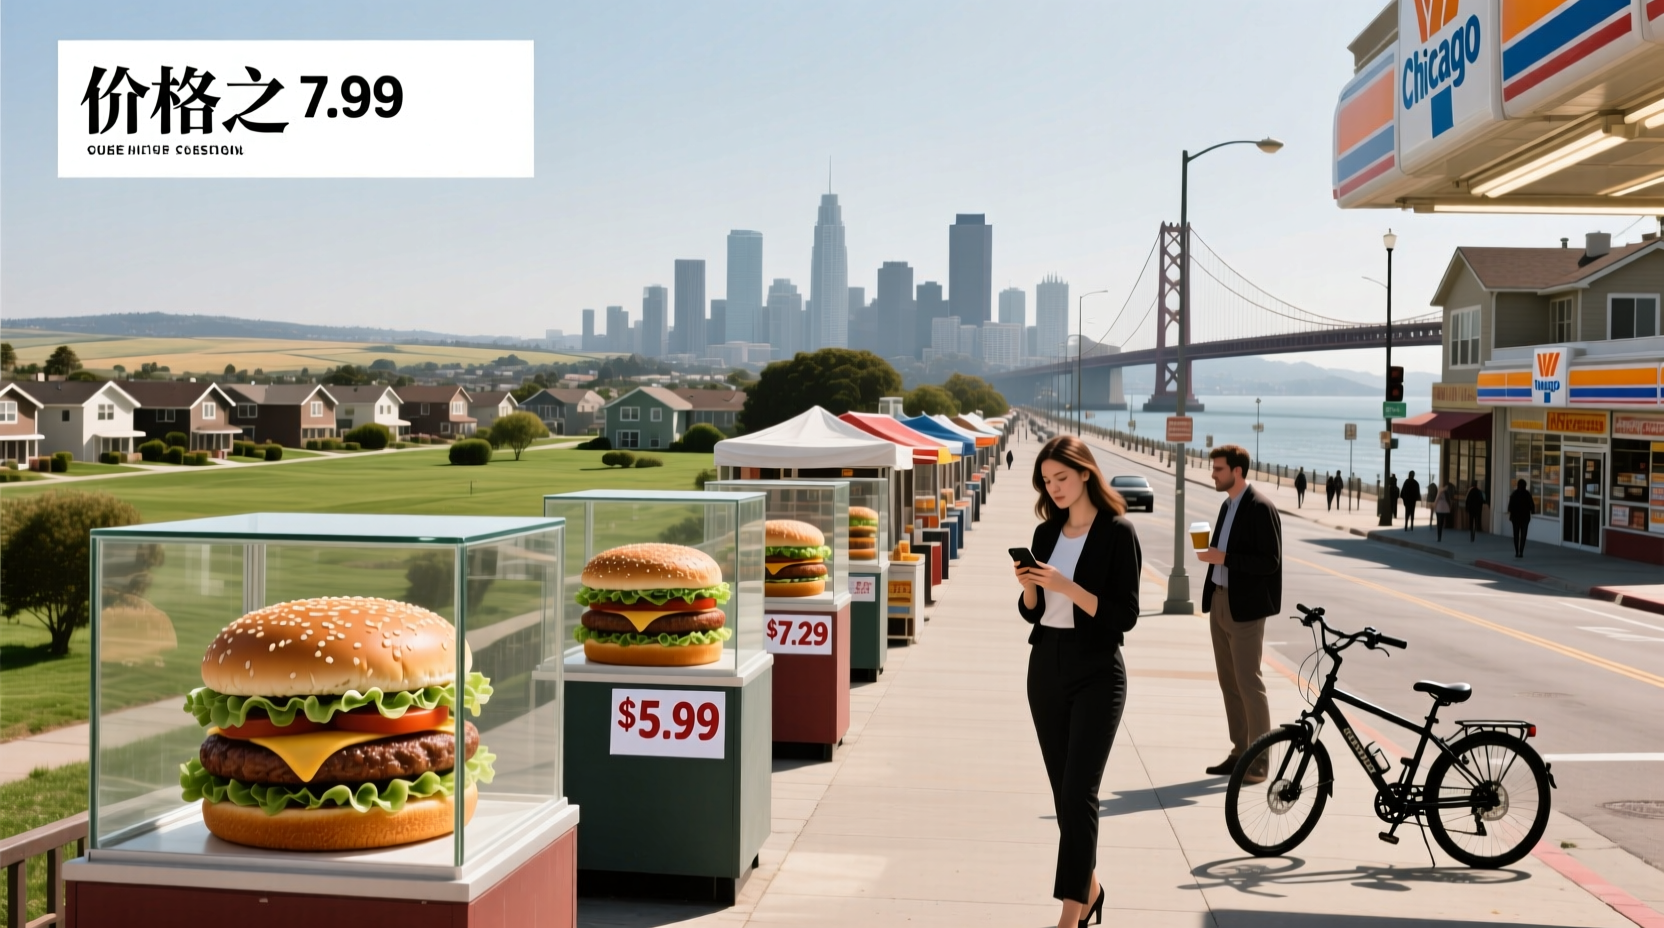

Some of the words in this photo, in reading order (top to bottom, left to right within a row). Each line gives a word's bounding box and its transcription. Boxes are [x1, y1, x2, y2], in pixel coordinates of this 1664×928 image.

[1403, 14, 1481, 110] Chicago
[766, 618, 829, 646] $7.29
[618, 696, 720, 741] $5.99
